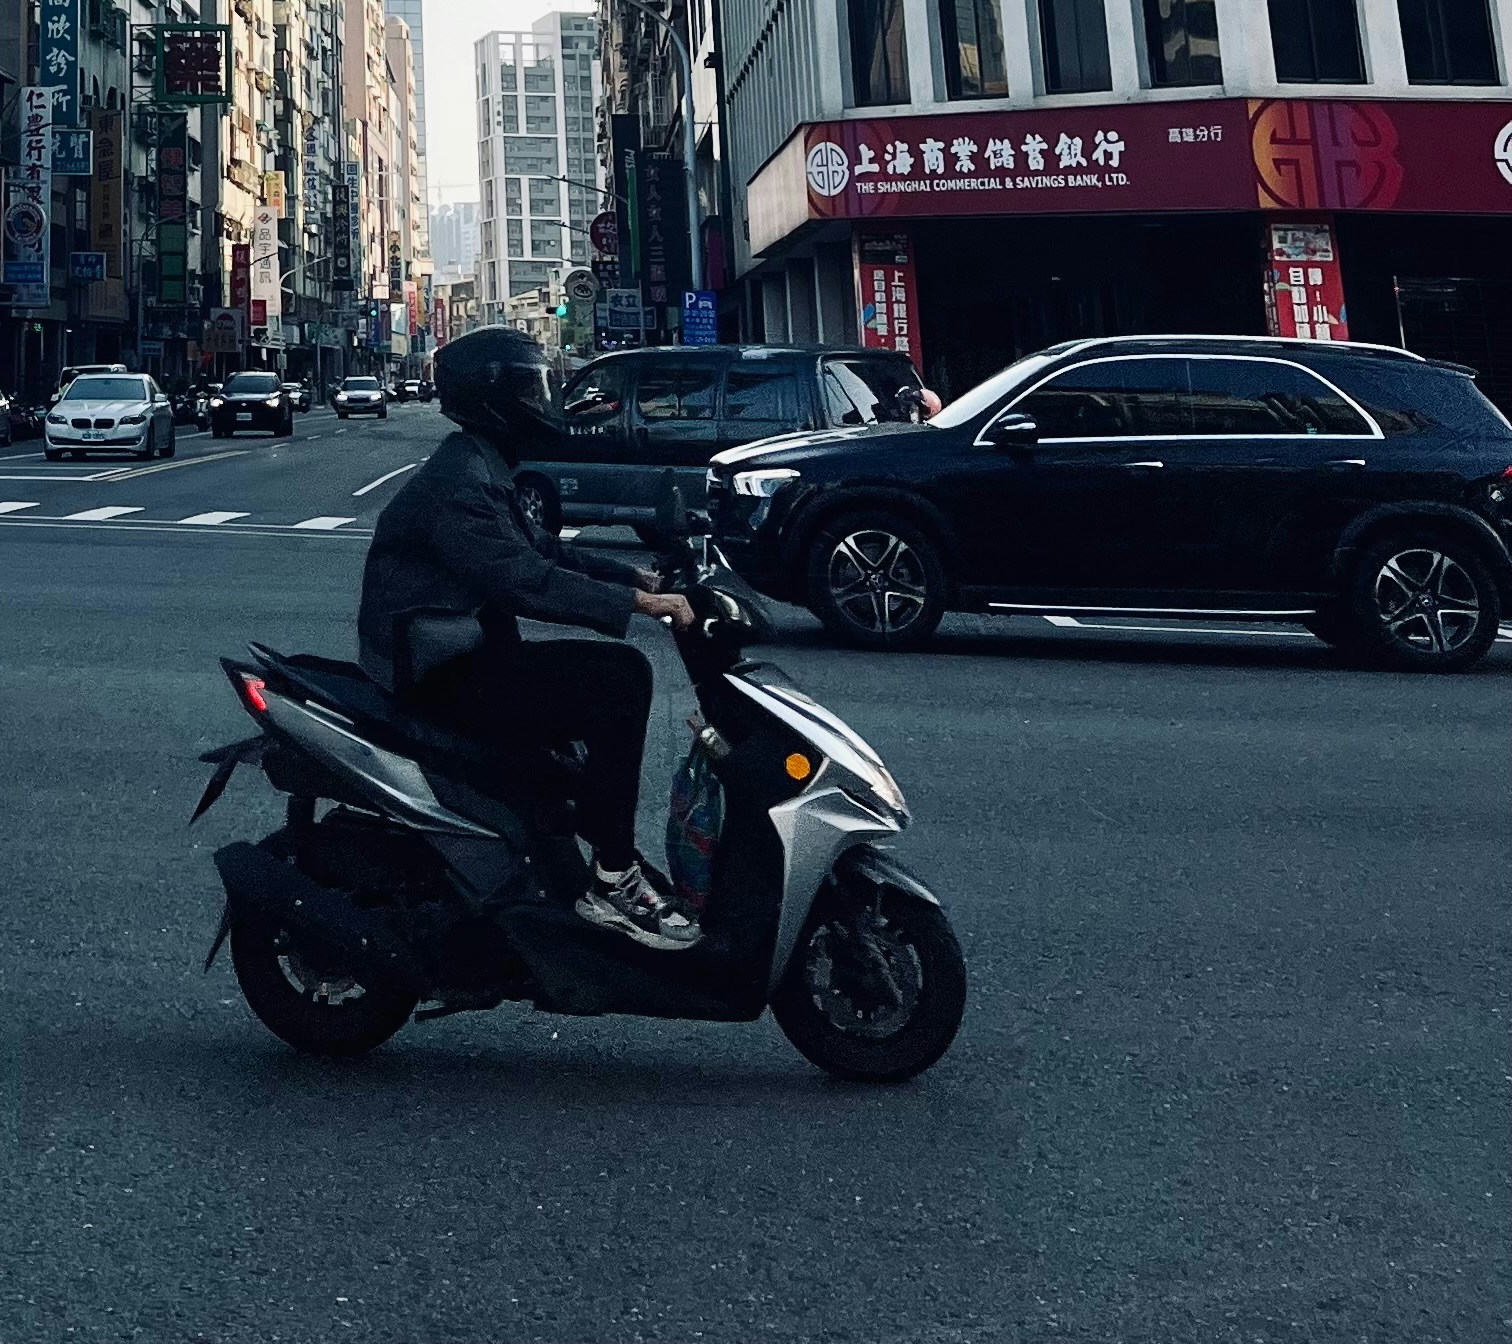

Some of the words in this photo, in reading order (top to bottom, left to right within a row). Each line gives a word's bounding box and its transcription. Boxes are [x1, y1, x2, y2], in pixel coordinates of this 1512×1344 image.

[1168, 125, 1223, 144] 高雄分行
[854, 129, 1126, 176] 上海商業儲蓄銀行
[855, 182, 876, 194] THE
[877, 179, 931, 193] SHANGHAI
[933, 176, 1003, 192] COMMERCIAL
[1005, 176, 1014, 189] &
[1015, 175, 1066, 189] SAVINGS
[1067, 174, 1102, 188] BANK,
[1105, 172, 1131, 185] LTD.
[685, 292, 697, 309] P
